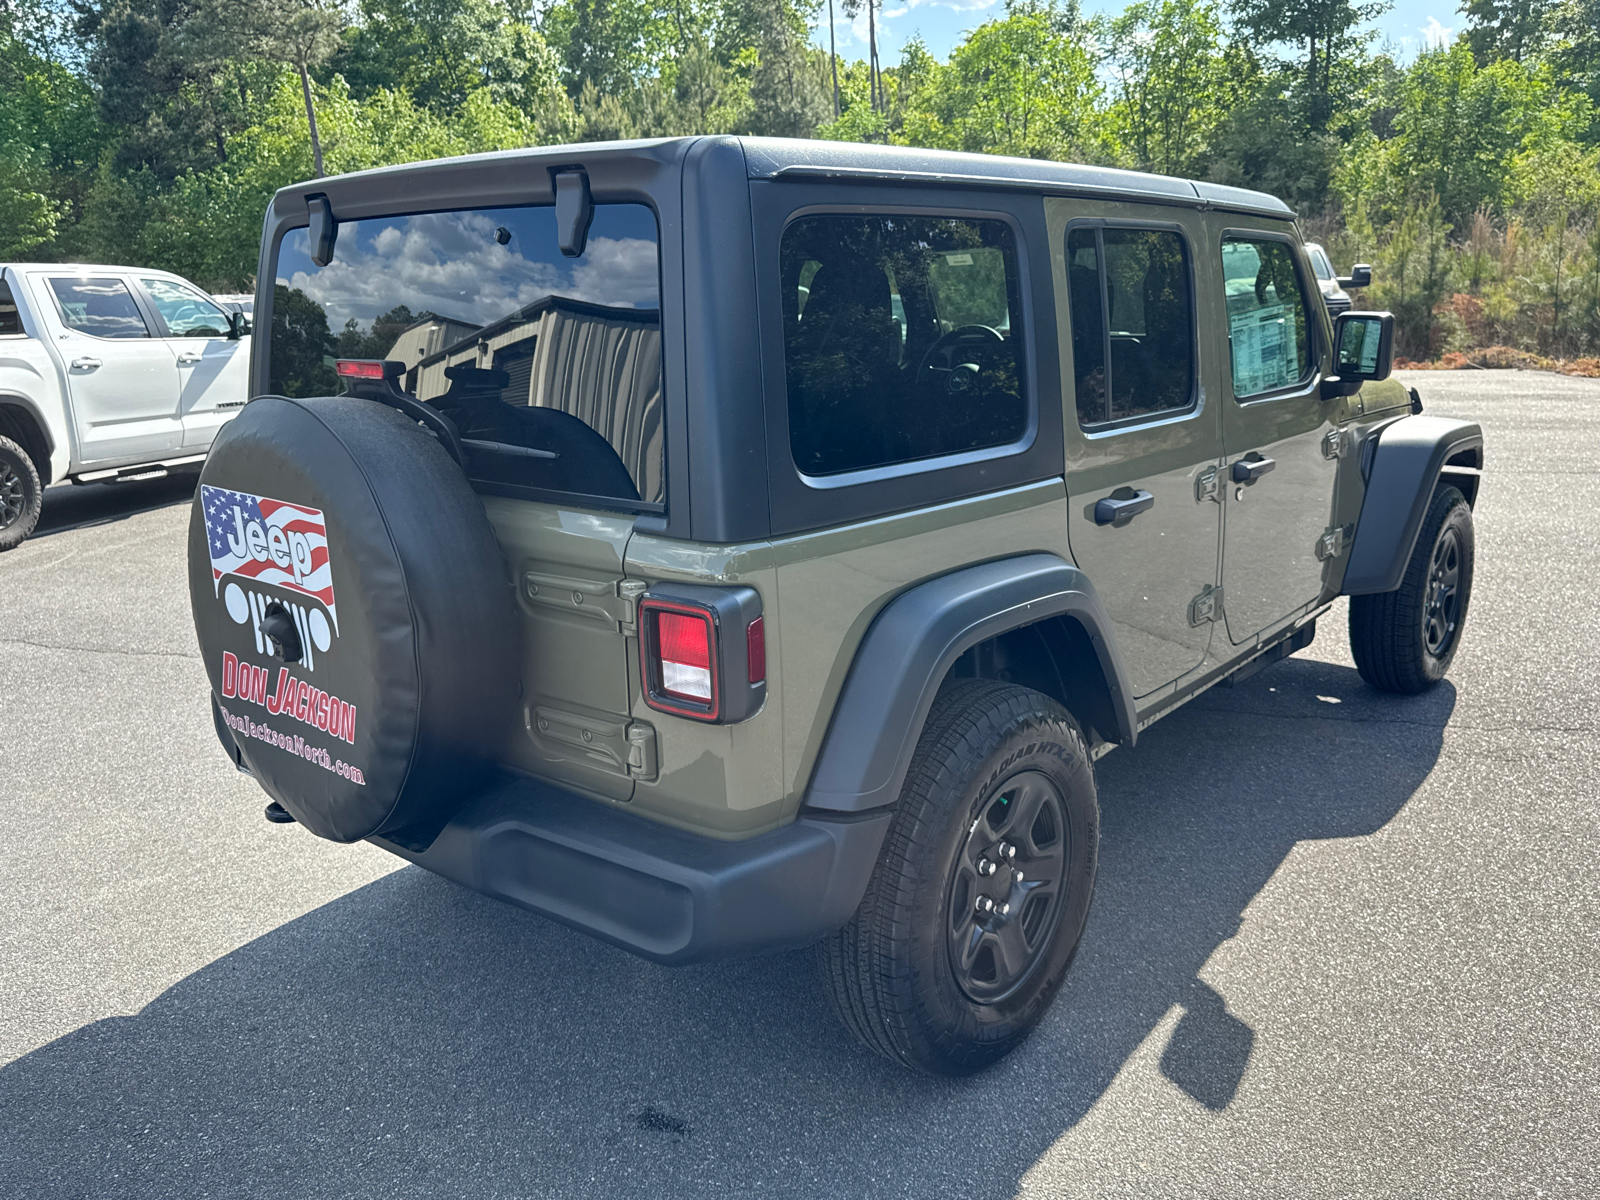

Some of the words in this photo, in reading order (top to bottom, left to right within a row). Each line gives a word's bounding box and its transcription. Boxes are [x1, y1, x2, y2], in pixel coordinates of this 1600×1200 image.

[227, 505, 313, 585] Jeep
[221, 650, 268, 707] DON
[265, 667, 358, 745] JACKSON
[221, 706, 366, 786] DonJacksonNorth.com
[968, 743, 1037, 818] ROADIAN
